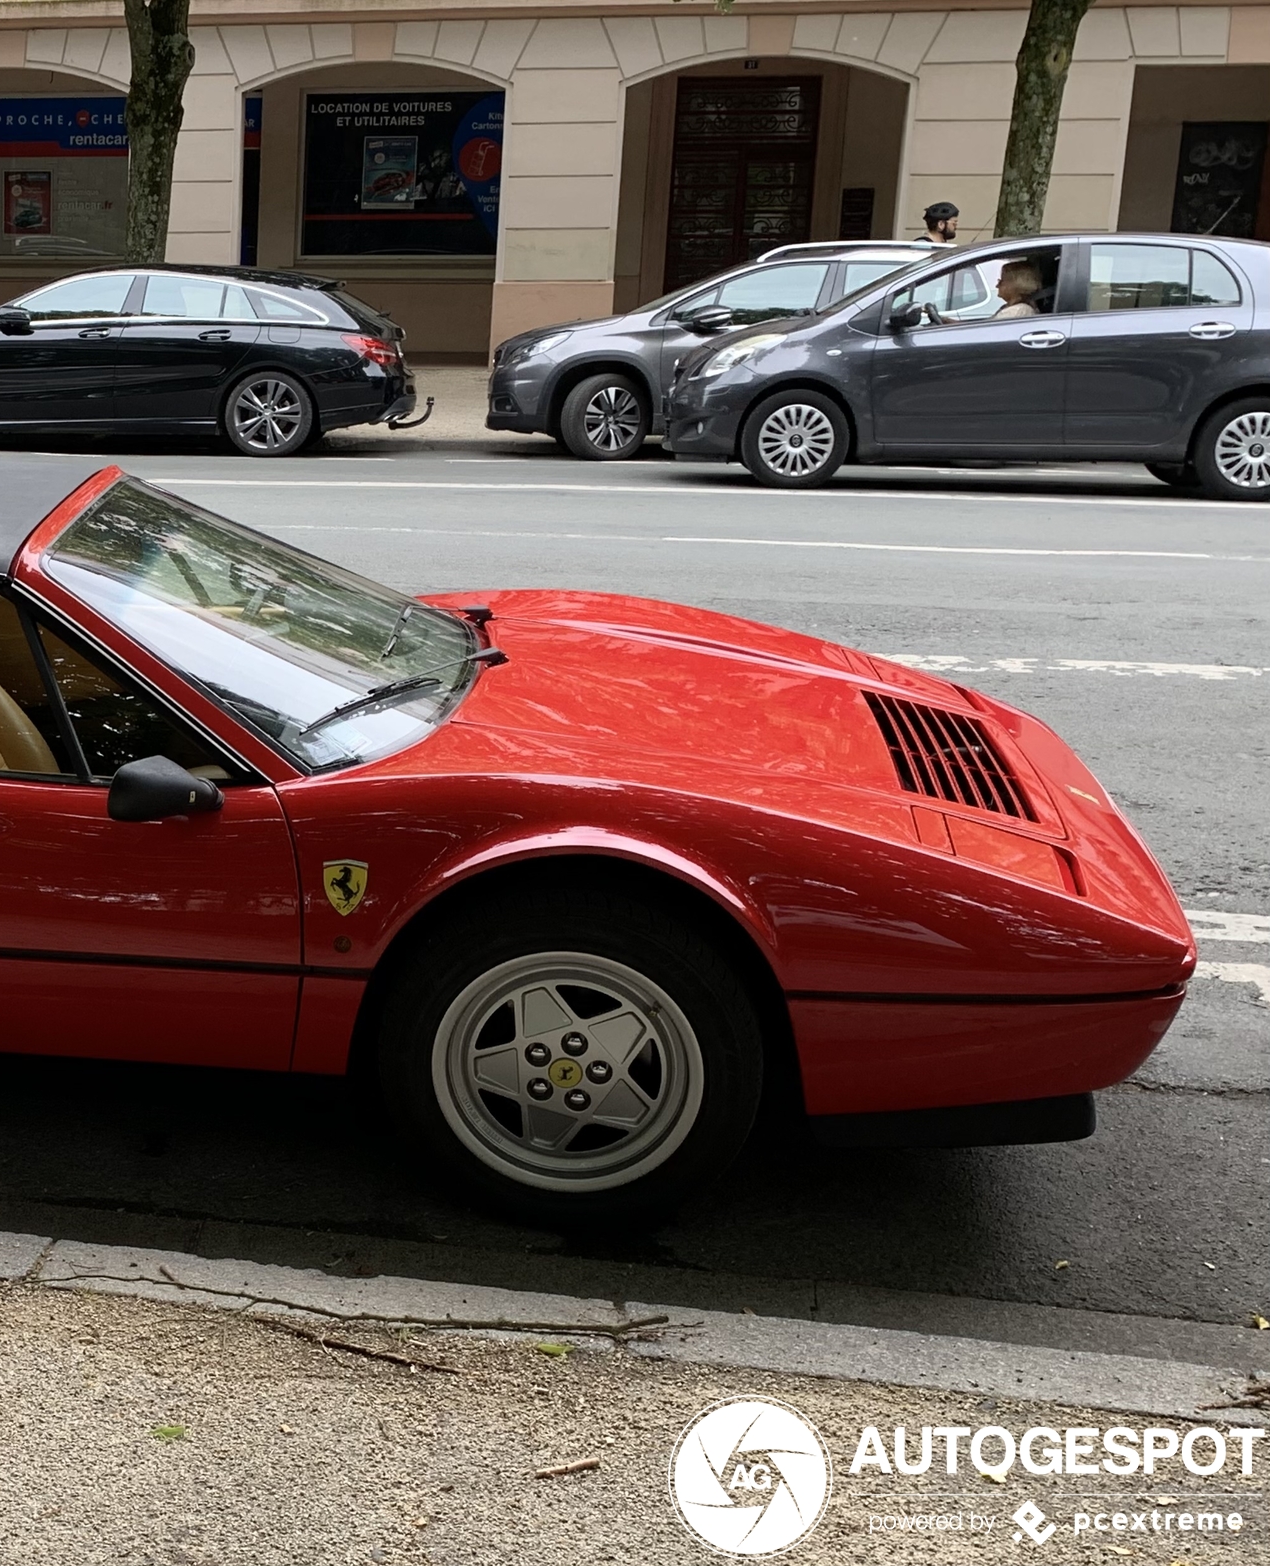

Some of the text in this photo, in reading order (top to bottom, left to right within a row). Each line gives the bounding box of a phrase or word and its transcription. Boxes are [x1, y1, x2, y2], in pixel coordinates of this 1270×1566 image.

[311, 102, 452, 114] LOCATION DE VOITURES
[336, 115, 425, 127] ET UTILITAIRES
[57, 200, 113, 210] rentacar.fr
